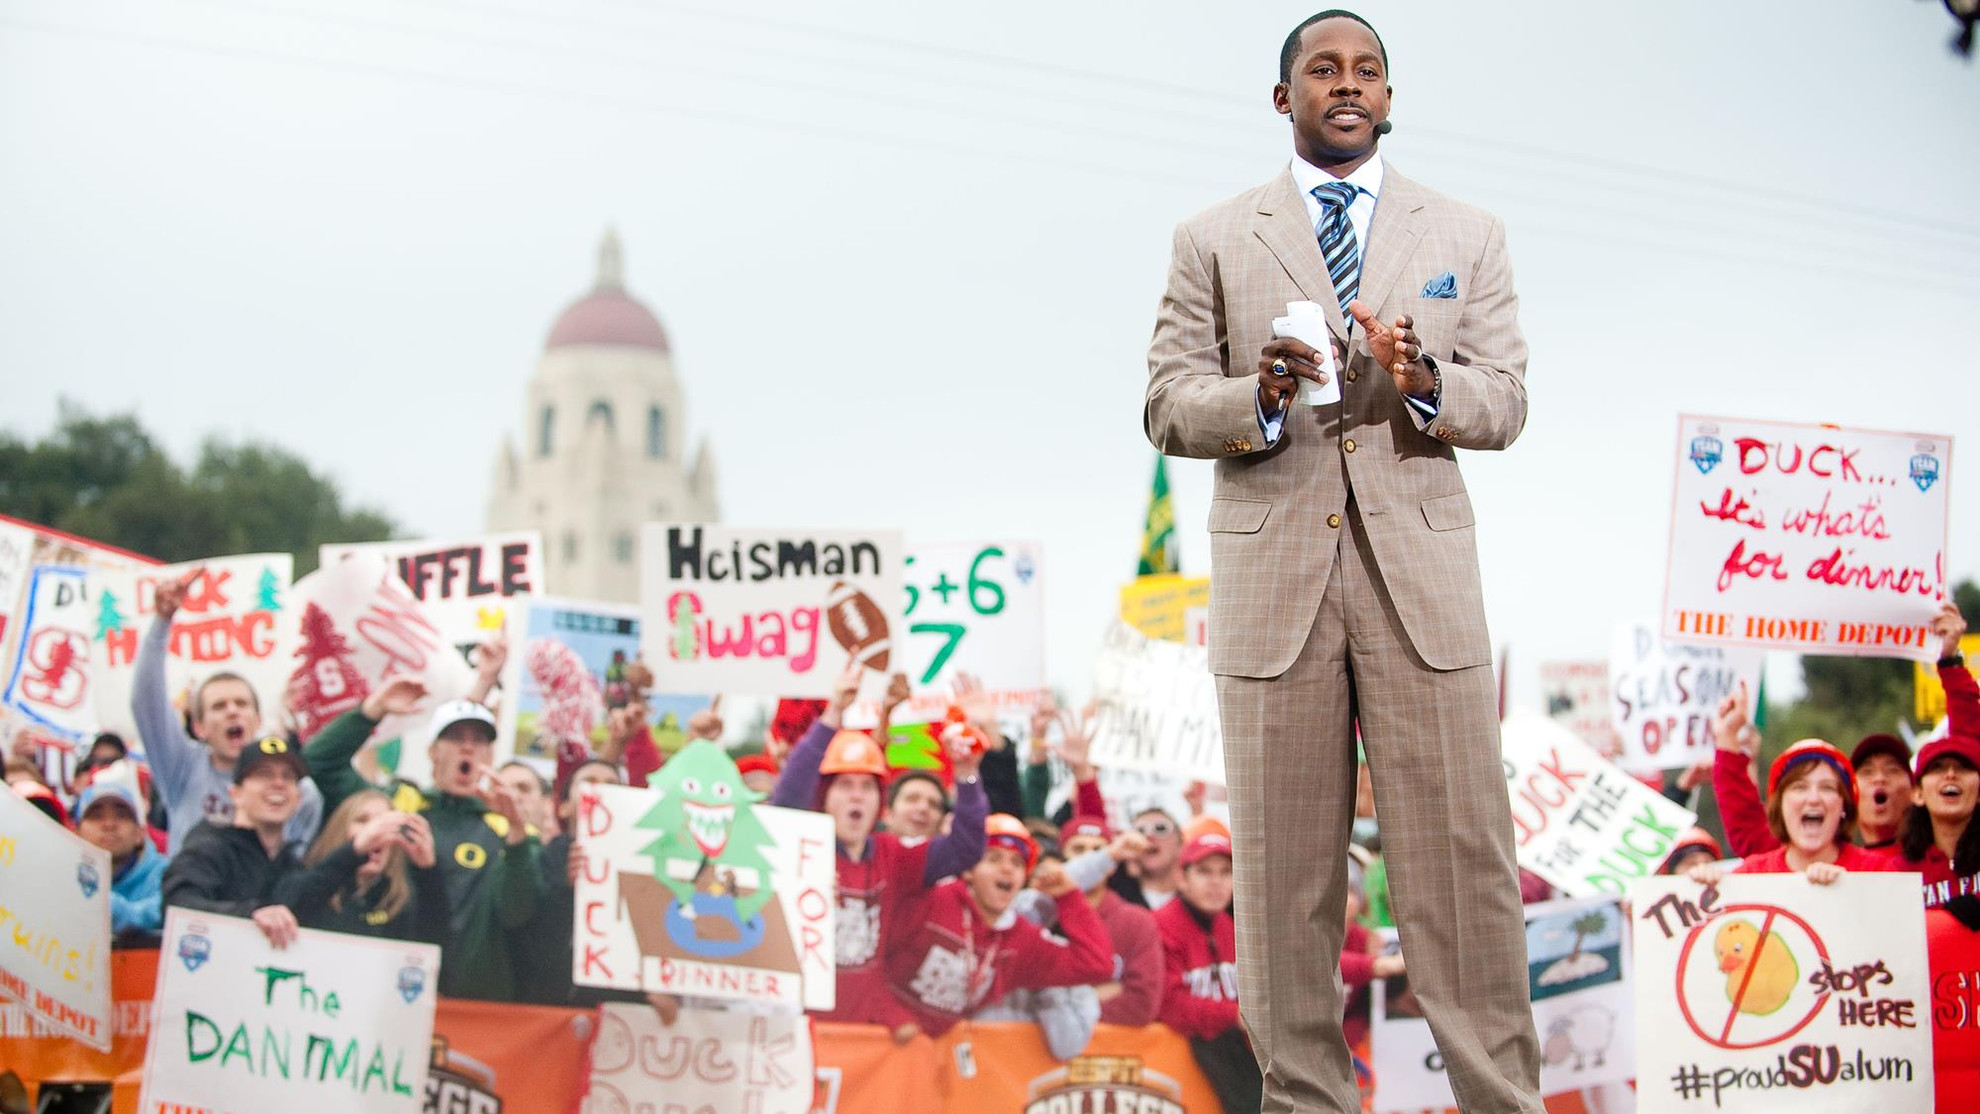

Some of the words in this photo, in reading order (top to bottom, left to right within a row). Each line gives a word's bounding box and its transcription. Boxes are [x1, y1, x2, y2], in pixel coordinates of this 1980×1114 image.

[1734, 438, 1896, 486] DUCK...
[1700, 487, 1765, 529] It's
[1782, 489, 1890, 540] what's
[1717, 538, 1788, 592] for
[1807, 546, 1945, 600] dinner!
[667, 590, 821, 673] Swag
[1675, 609, 1733, 637] THE
[1745, 615, 1828, 643] HOME
[1837, 620, 1934, 648] DEPOT
[1617, 664, 1734, 722] SEASON
[1511, 748, 1587, 847] UCK
[1568, 774, 1628, 833] THE
[1585, 804, 1679, 895] DUCK
[582, 795, 614, 980] DUCK
[798, 837, 830, 971] FOR
[1642, 885, 1725, 939] The
[256, 966, 342, 1018] The
[660, 956, 780, 998] DINNER
[1809, 959, 1894, 998] stops
[1839, 999, 1917, 1029] HERE
[1671, 1044, 1913, 1108] #proudSUalum
